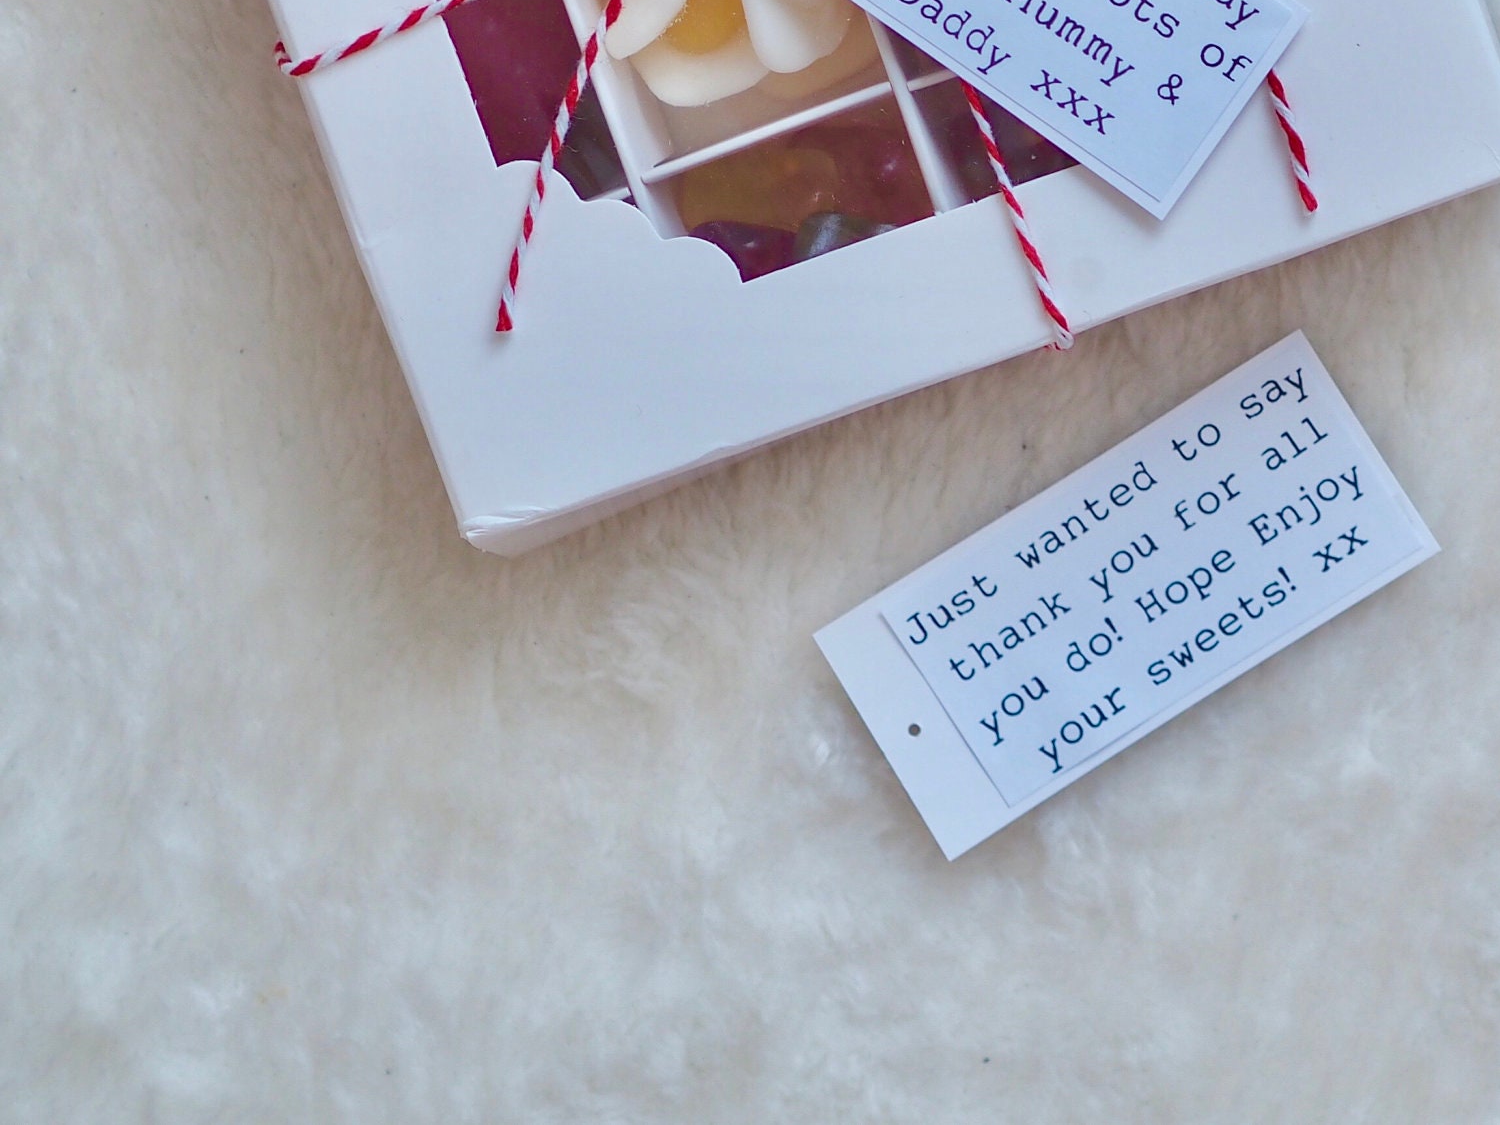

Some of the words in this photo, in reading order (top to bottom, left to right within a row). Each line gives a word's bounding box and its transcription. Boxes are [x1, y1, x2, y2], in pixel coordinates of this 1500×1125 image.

[1157, 74, 1183, 106] &
[1200, 44, 1253, 82] of
[907, 576, 997, 645] Just
[1015, 461, 1158, 568] wanted
[1172, 424, 1221, 461] to
[1240, 368, 1308, 419] say
[950, 593, 1071, 680] thank
[1089, 534, 1159, 603] you
[1175, 473, 1240, 531] for
[1261, 417, 1328, 470] all
[980, 676, 1049, 746] you
[1134, 550, 1235, 623] Hope
[1248, 466, 1363, 546] Enjoy
[1039, 687, 1126, 773] your
